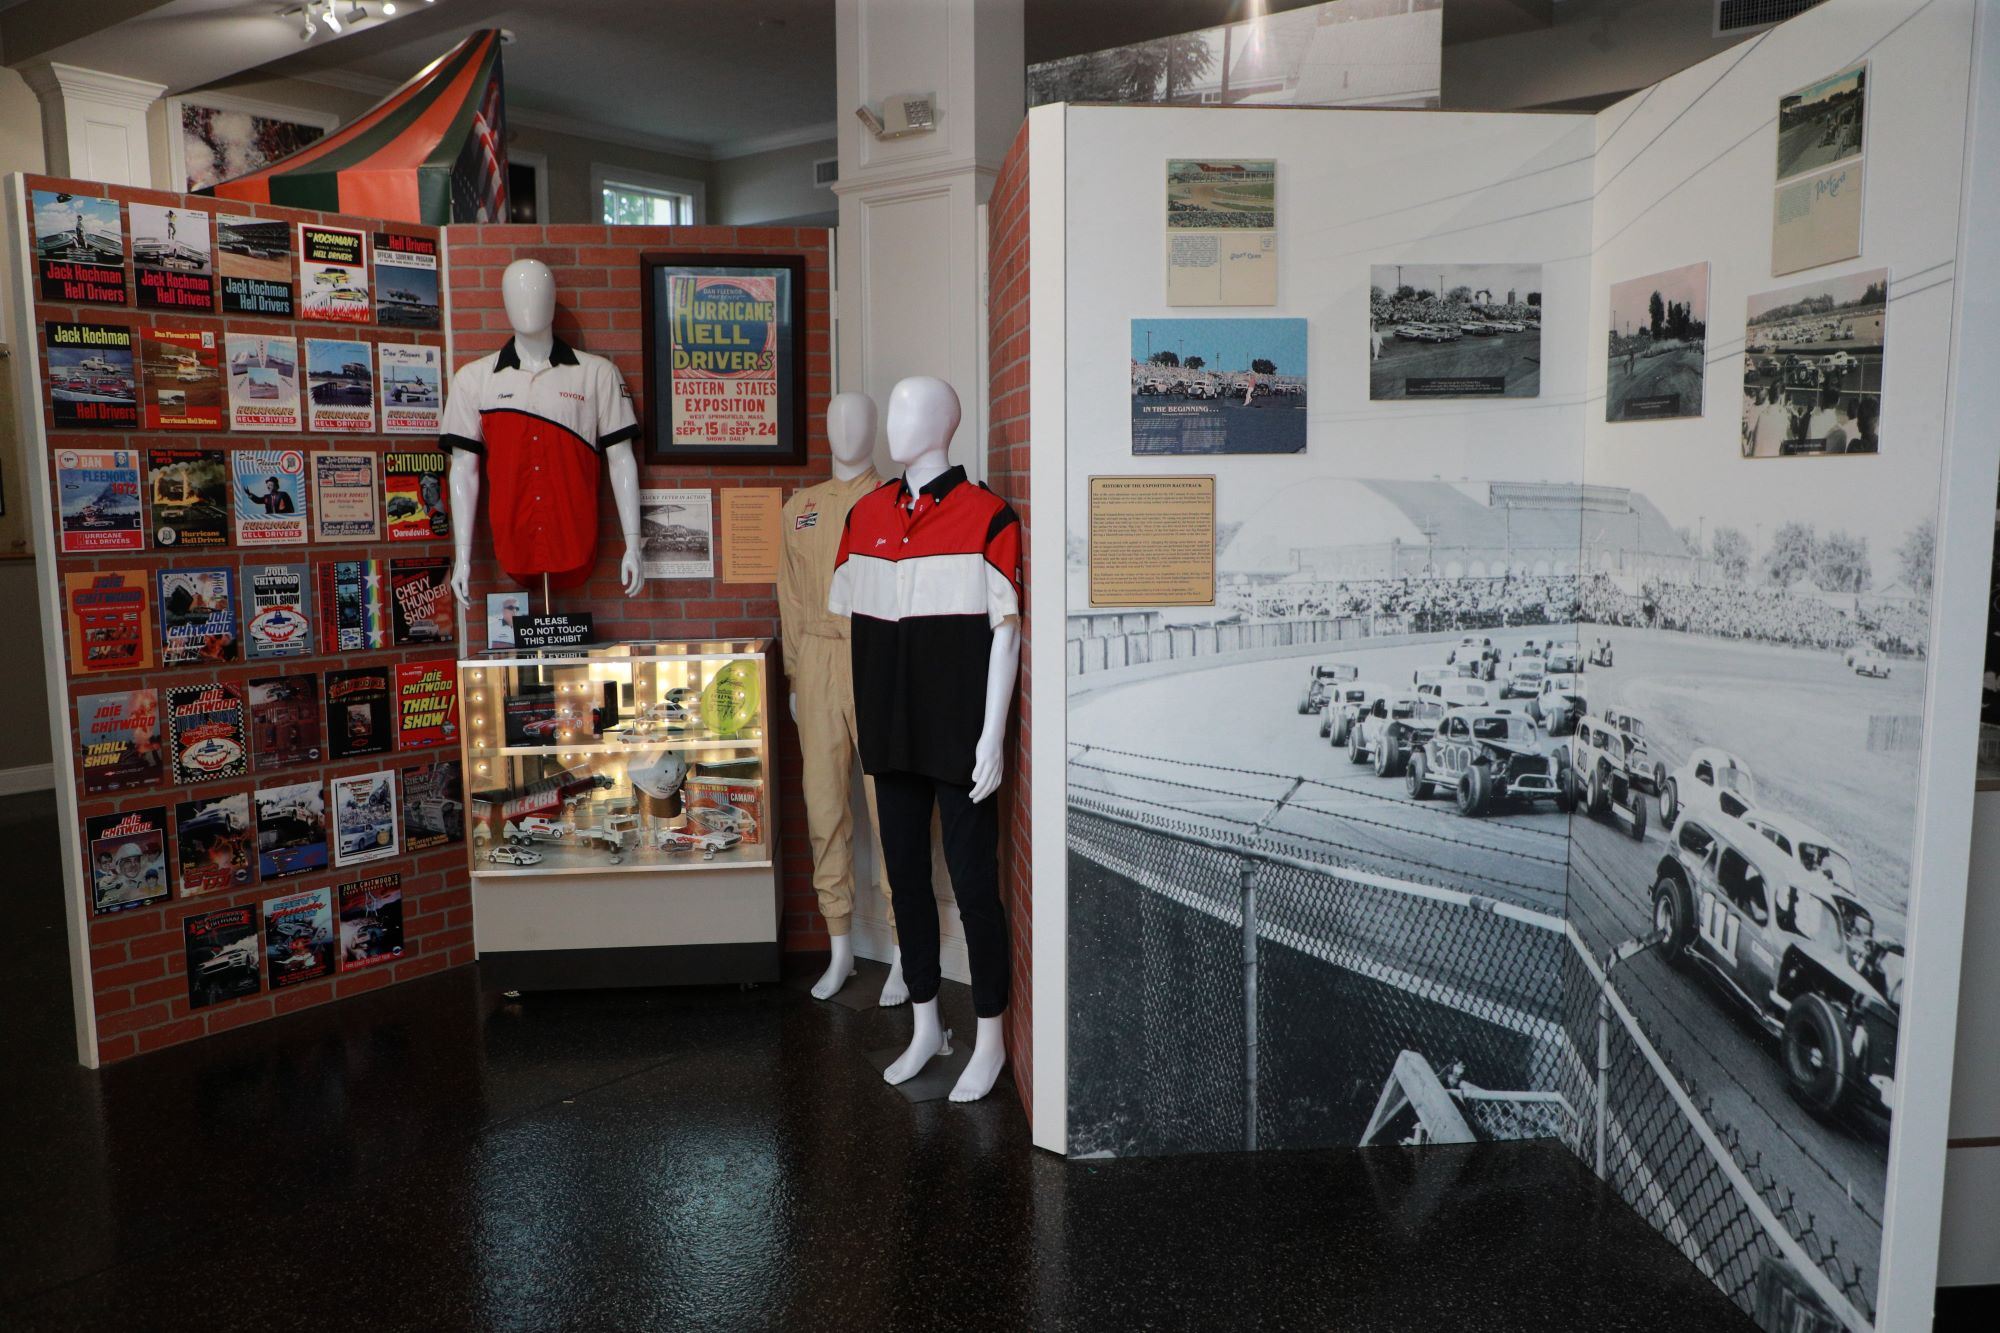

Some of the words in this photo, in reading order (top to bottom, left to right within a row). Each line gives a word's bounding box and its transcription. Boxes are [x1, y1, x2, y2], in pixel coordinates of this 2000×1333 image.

[389, 234, 404, 251] Hell
[405, 236, 433, 254] Drivers
[47, 263, 73, 280] Jack
[75, 264, 122, 285] Kochman
[141, 268, 165, 287] Jack
[166, 271, 210, 291] Kochman
[64, 282, 86, 299] Hell
[87, 283, 125, 303] Drivers
[225, 277, 248, 295] Jack
[249, 279, 289, 298] Kochman
[157, 288, 176, 304] Hell
[177, 289, 212, 307] Drivers
[240, 294, 257, 311] Hell
[258, 295, 290, 313] Drivers
[54, 325, 81, 343] Jack
[82, 326, 130, 346] Kochman
[673, 350, 774, 371] DRIVERS
[559, 391, 585, 402] TOYOTA
[675, 382, 725, 396] EASTERN
[736, 382, 777, 396] STATES
[76, 402, 97, 419] Hell
[99, 404, 136, 420] Drivers
[685, 399, 765, 413] EXPOSITION
[1143, 405, 1151, 413] IN
[1151, 405, 1167, 413] THE
[259, 416, 295, 424] DRIVERS
[336, 420, 371, 428] DRIVERS
[676, 426, 705, 436] SEPT.
[705, 422, 718, 435] 15
[729, 427, 757, 436] SEPT.
[758, 422, 776, 436] 24
[386, 453, 445, 473] CHITWOOD
[82, 470, 137, 482] FLEENOR'S
[111, 482, 137, 495] 1972
[265, 530, 299, 538] DRIVERS
[392, 528, 430, 538] Daredevils
[254, 575, 299, 586] CHITWOOD
[395, 576, 431, 600] CHEVY
[256, 594, 278, 606] THRILL
[280, 594, 300, 604] SHOW
[399, 583, 448, 613] THUNDER
[207, 610, 233, 623] JOIE
[403, 603, 436, 626] SHOW
[534, 617, 568, 625] PLEASE
[170, 622, 231, 637] CHITWOOD
[520, 628, 534, 636] DO
[536, 627, 554, 635] NOT
[557, 625, 588, 634] TOUCH
[524, 637, 545, 645] THIS
[547, 635, 581, 644] EXHIBIT
[421, 668, 442, 682] JOIE
[200, 689, 225, 701] JOIE
[402, 680, 453, 695] CHITWOOD
[94, 703, 122, 719] JOIE
[176, 699, 239, 717] CHITWOOD
[403, 693, 448, 714] THRILL
[91, 716, 156, 734] CHITWOOD
[403, 711, 446, 730] SHOW
[87, 741, 127, 756] THRILL
[84, 753, 121, 768] SHOW
[730, 792, 755, 803] CAMARO
[101, 822, 153, 839] CHITWOOD
[343, 883, 359, 892] JOIE
[360, 874, 399, 889] CHITWOOD'S
